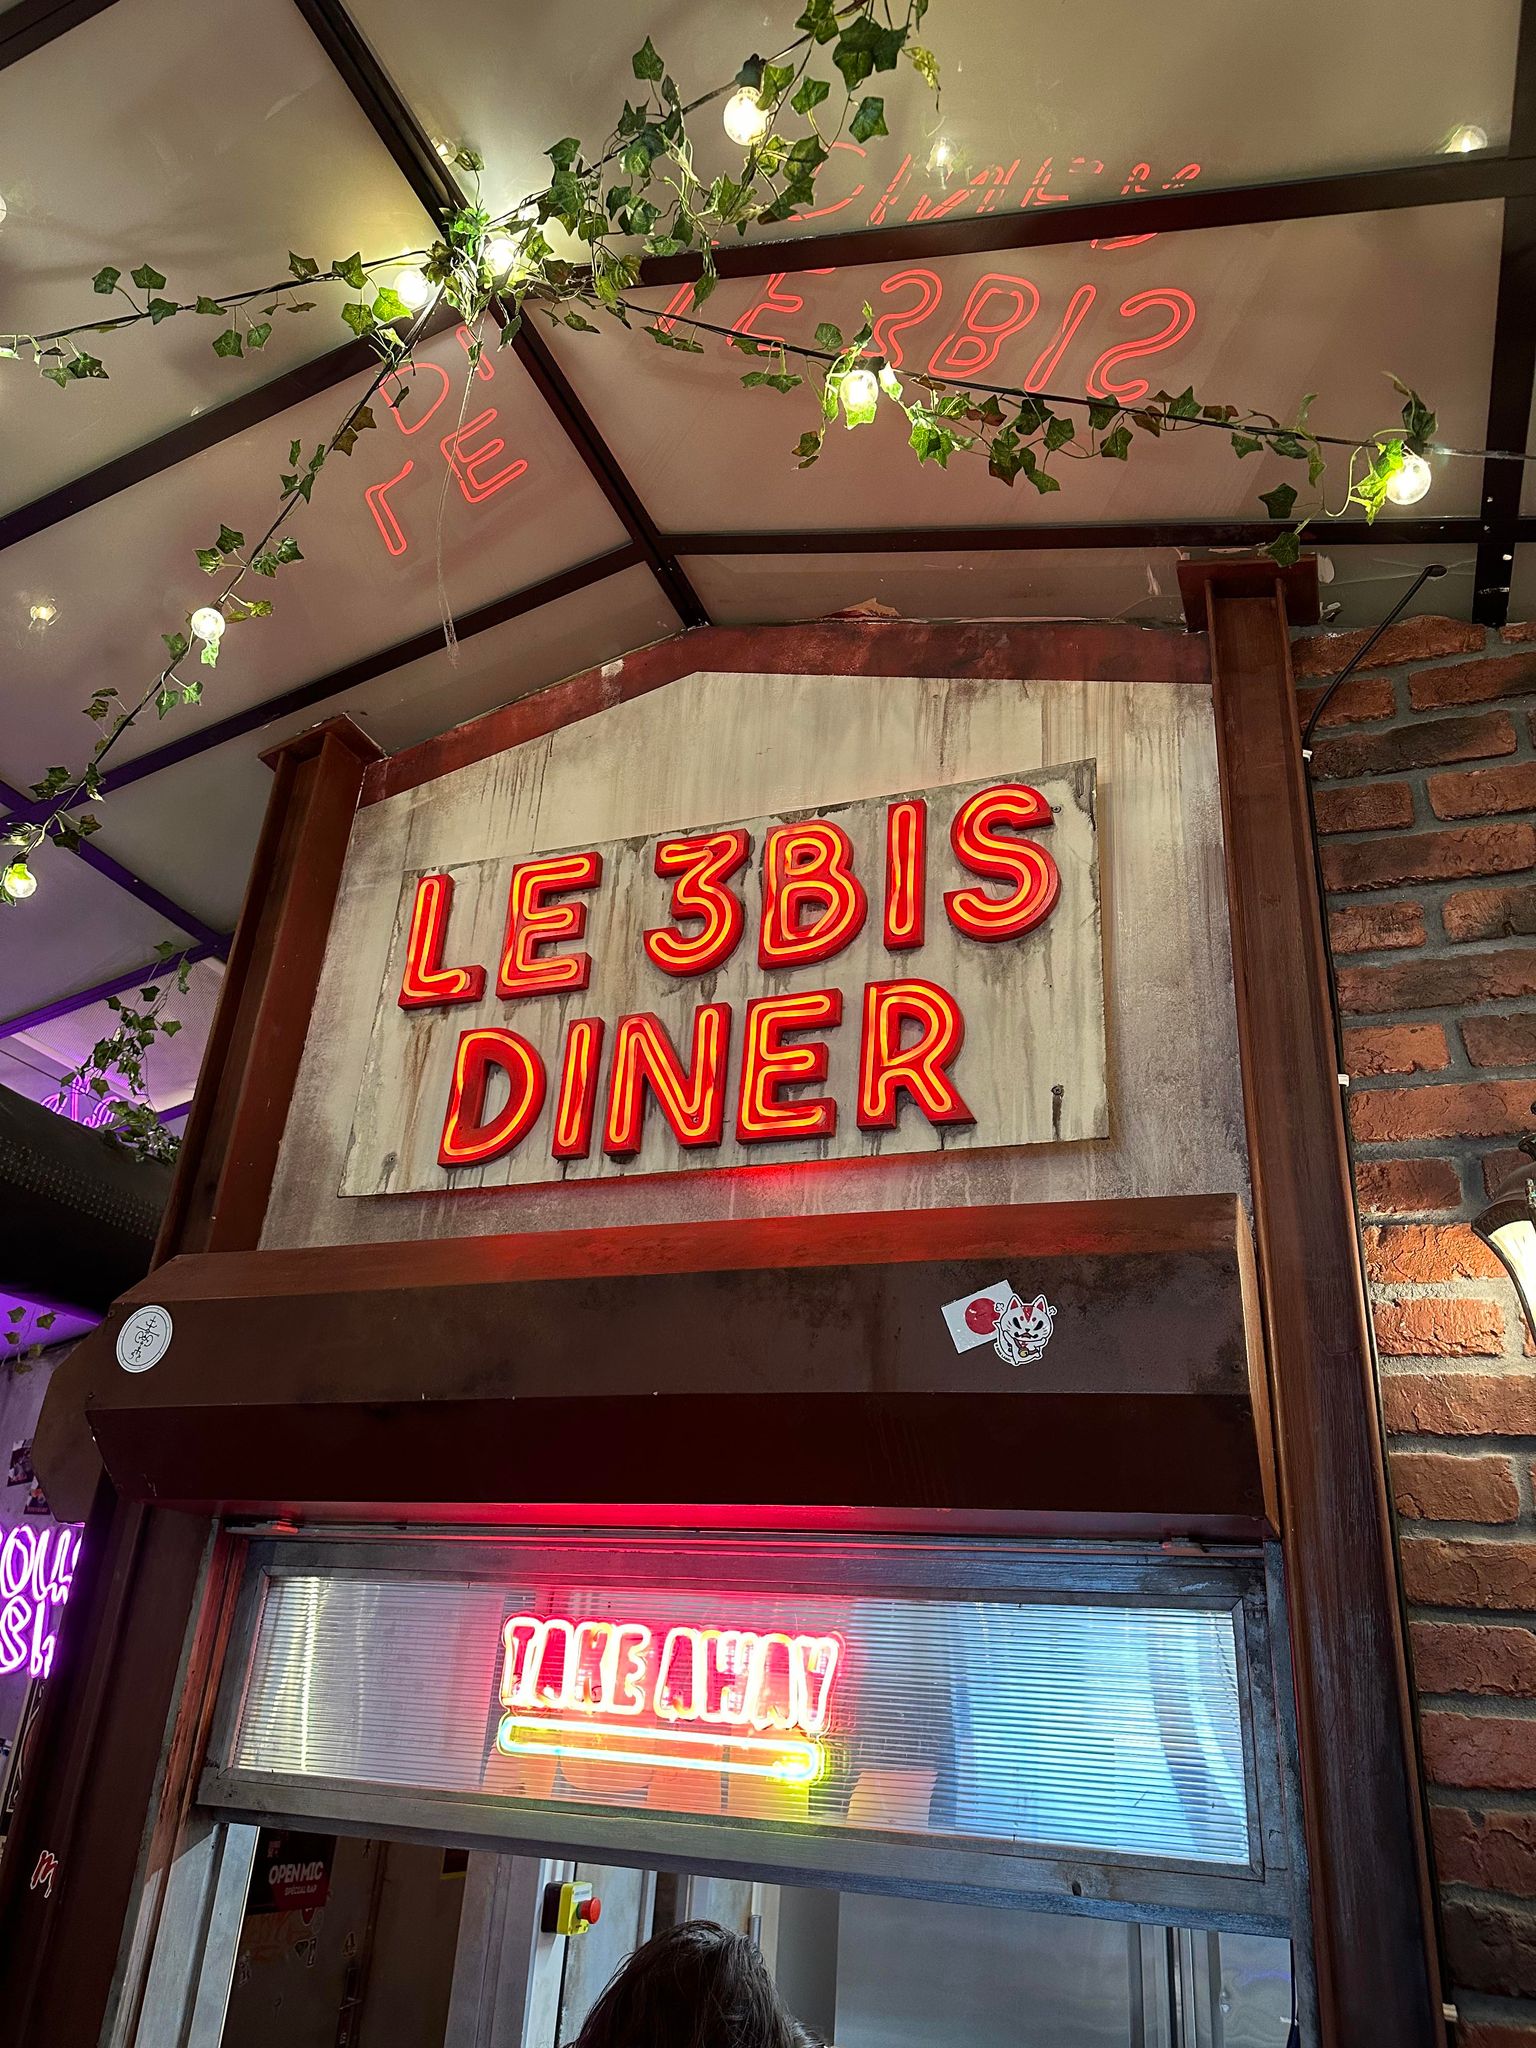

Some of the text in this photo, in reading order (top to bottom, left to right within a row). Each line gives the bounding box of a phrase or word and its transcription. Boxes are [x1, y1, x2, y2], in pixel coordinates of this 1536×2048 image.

[398, 783, 1062, 1010] LE 3BIS
[436, 977, 977, 1169] DINER
[501, 1614, 844, 1733] TAKE AWAY
[268, 1860, 324, 1886] OPEN MIC
